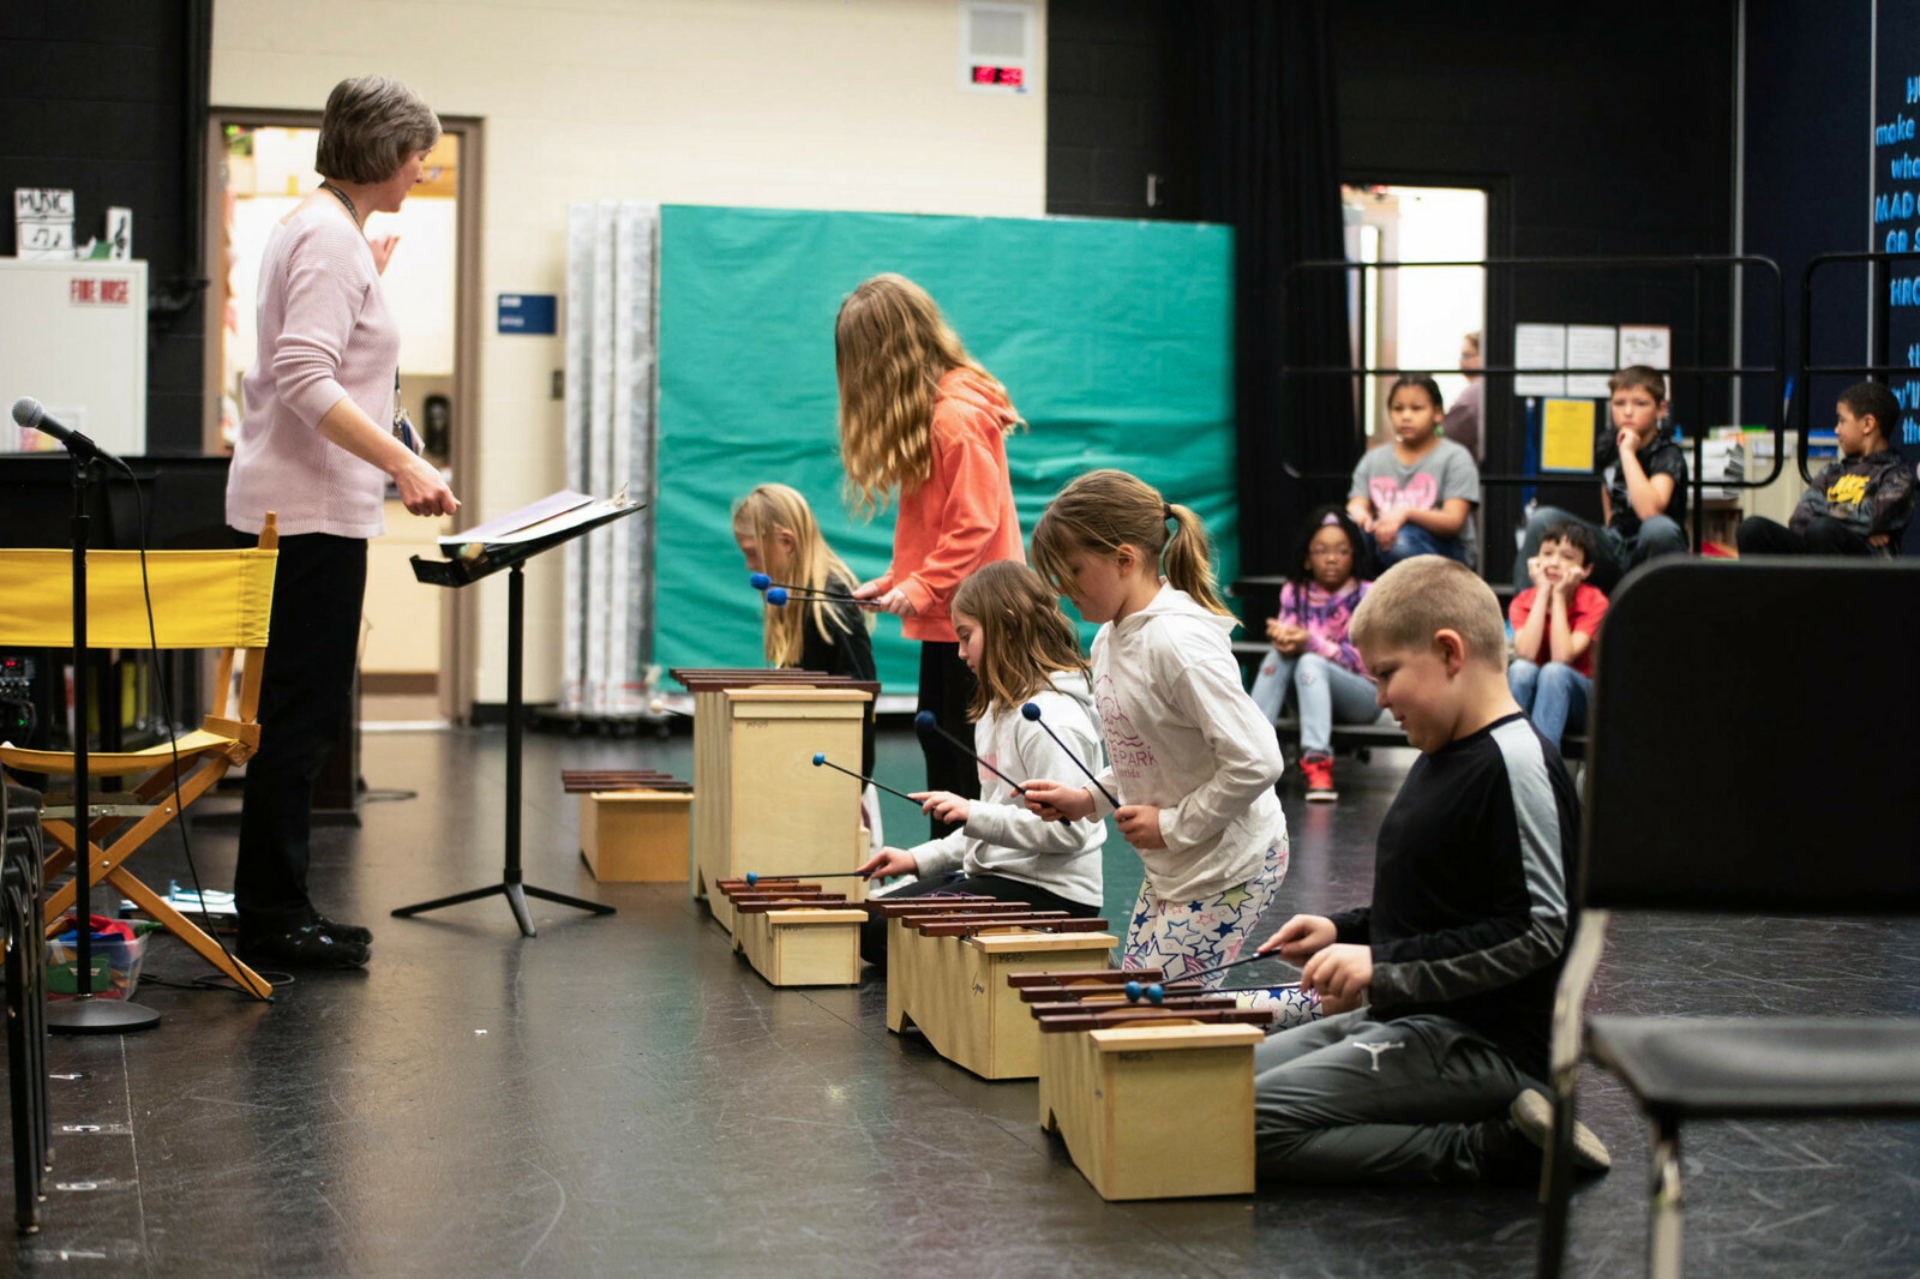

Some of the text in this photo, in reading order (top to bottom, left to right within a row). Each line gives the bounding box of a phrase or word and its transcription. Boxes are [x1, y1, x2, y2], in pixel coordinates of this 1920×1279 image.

[1876, 112, 1915, 147] make
[19, 189, 67, 214] MUSIC
[1875, 191, 1914, 224] MAD
[70, 278, 129, 305] FIRE HOSE
[1889, 277, 1920, 307] HRO
[1902, 416, 1920, 444] th
